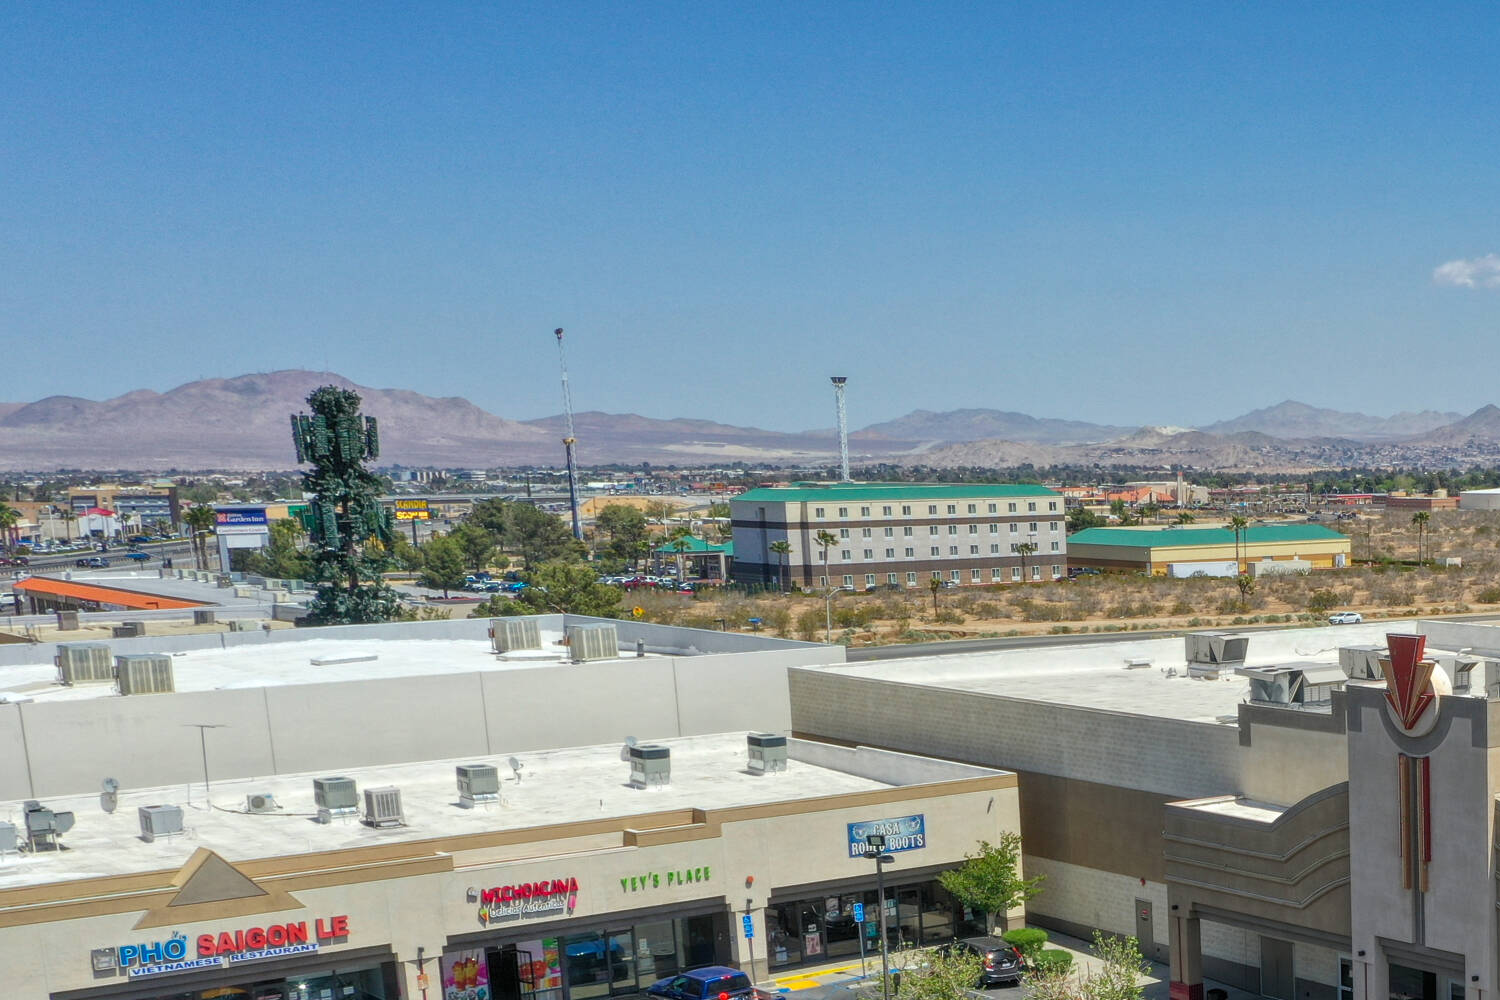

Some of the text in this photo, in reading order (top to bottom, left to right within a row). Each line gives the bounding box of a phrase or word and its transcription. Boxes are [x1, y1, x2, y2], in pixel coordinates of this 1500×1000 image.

[873, 822, 899, 836] CASA
[889, 834, 923, 850] BOOTS
[481, 877, 580, 904] MICHOACANA
[620, 866, 711, 892] YEY'S PLACE
[197, 921, 308, 956] SAIGON
[316, 915, 349, 939] LE
[132, 957, 220, 976] VIETNAMESE
[231, 944, 319, 962] RESTAURANT
